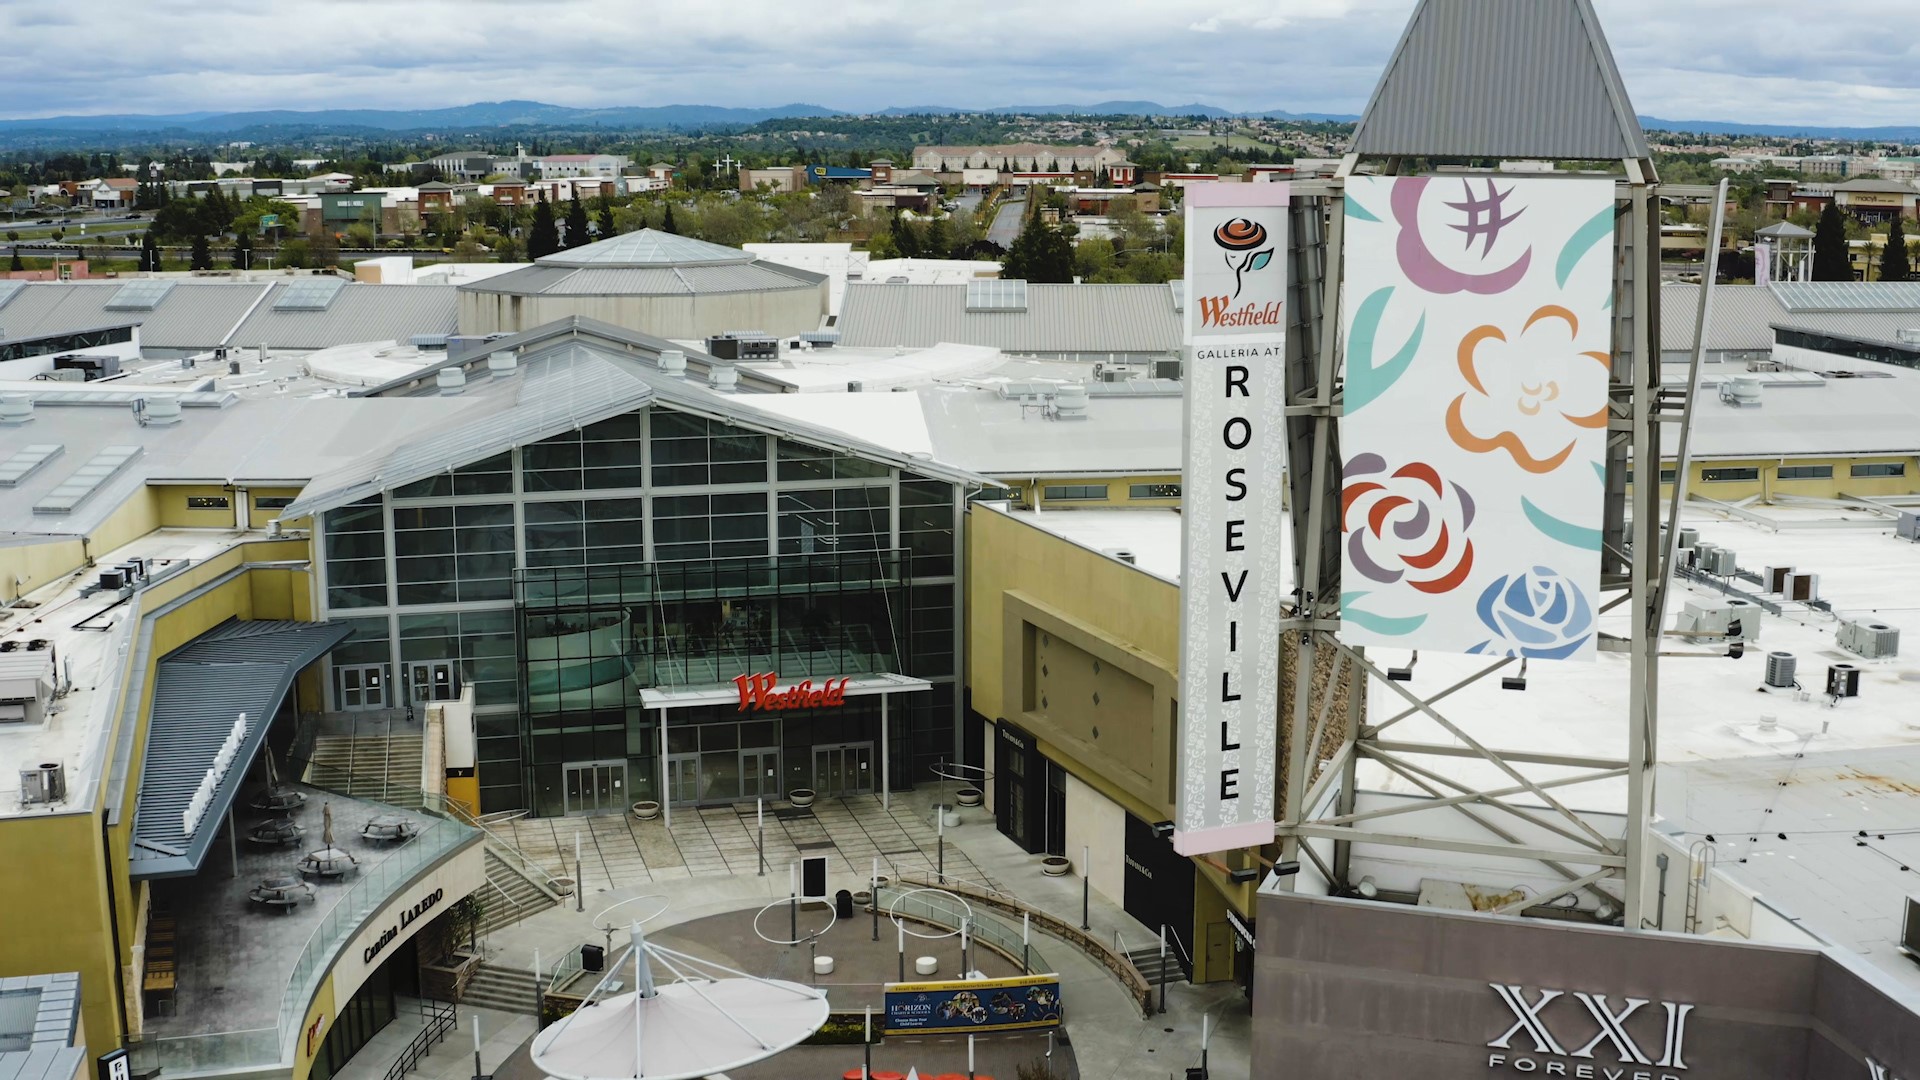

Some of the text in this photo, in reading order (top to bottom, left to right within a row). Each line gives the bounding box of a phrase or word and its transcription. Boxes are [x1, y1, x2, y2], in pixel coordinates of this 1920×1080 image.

[1197, 295, 1283, 328] Westfield
[1197, 347, 1280, 360] GALLERIA AT
[1220, 365, 1252, 801] ROSEVILLE
[732, 671, 850, 713] Westfield
[364, 887, 443, 964] Cantina LAREDO
[891, 1004, 932, 1012] HORIZON
[1487, 982, 1695, 1070] XXI
